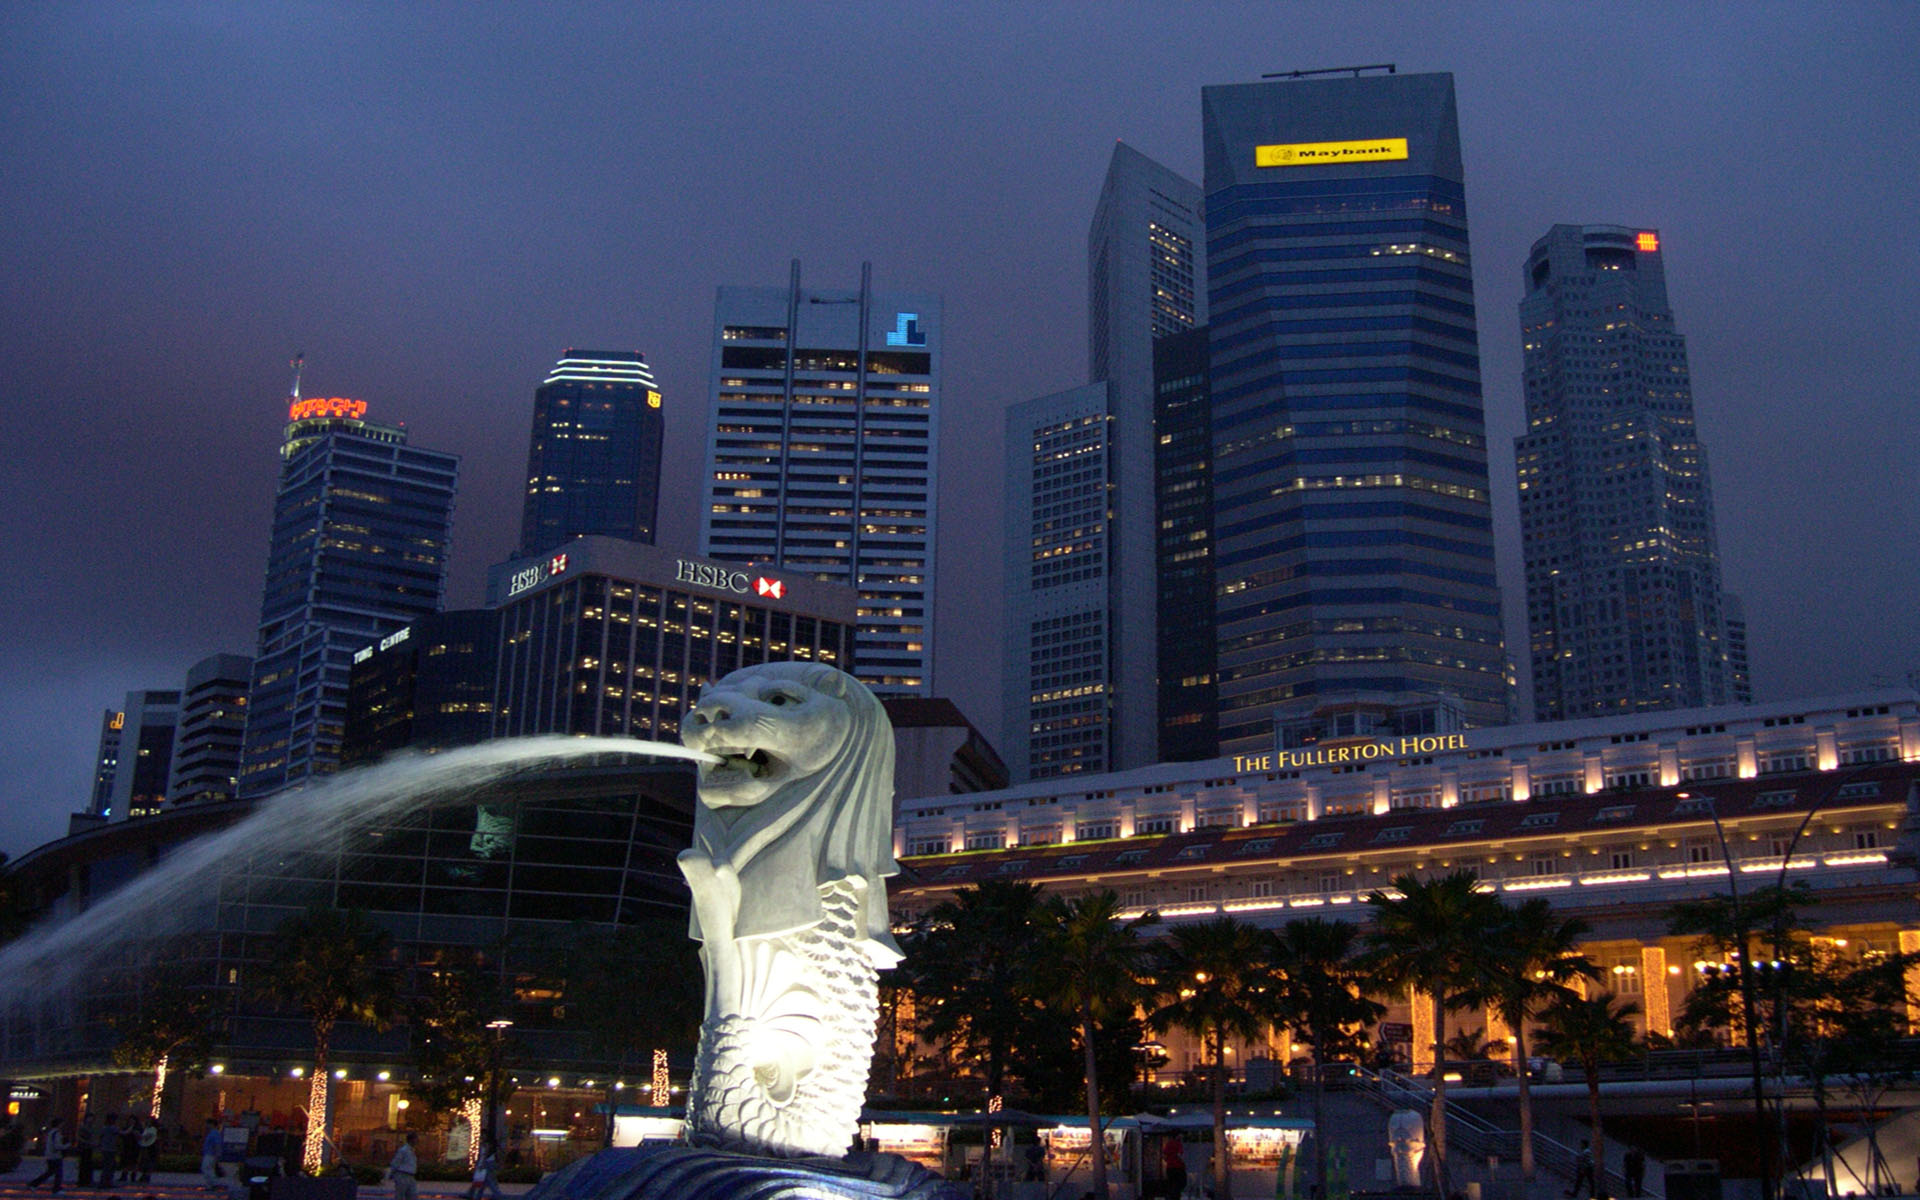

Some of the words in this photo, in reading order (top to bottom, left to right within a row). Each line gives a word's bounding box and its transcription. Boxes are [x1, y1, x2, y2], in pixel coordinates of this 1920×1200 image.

[1299, 146, 1392, 157] Maybank
[290, 397, 367, 417] HITACHI
[508, 561, 549, 596] HSBC
[676, 559, 749, 593] HSBC
[1233, 755, 1271, 773] THE
[1278, 741, 1395, 769] FULLERTON
[1400, 734, 1469, 755] HOTEL
